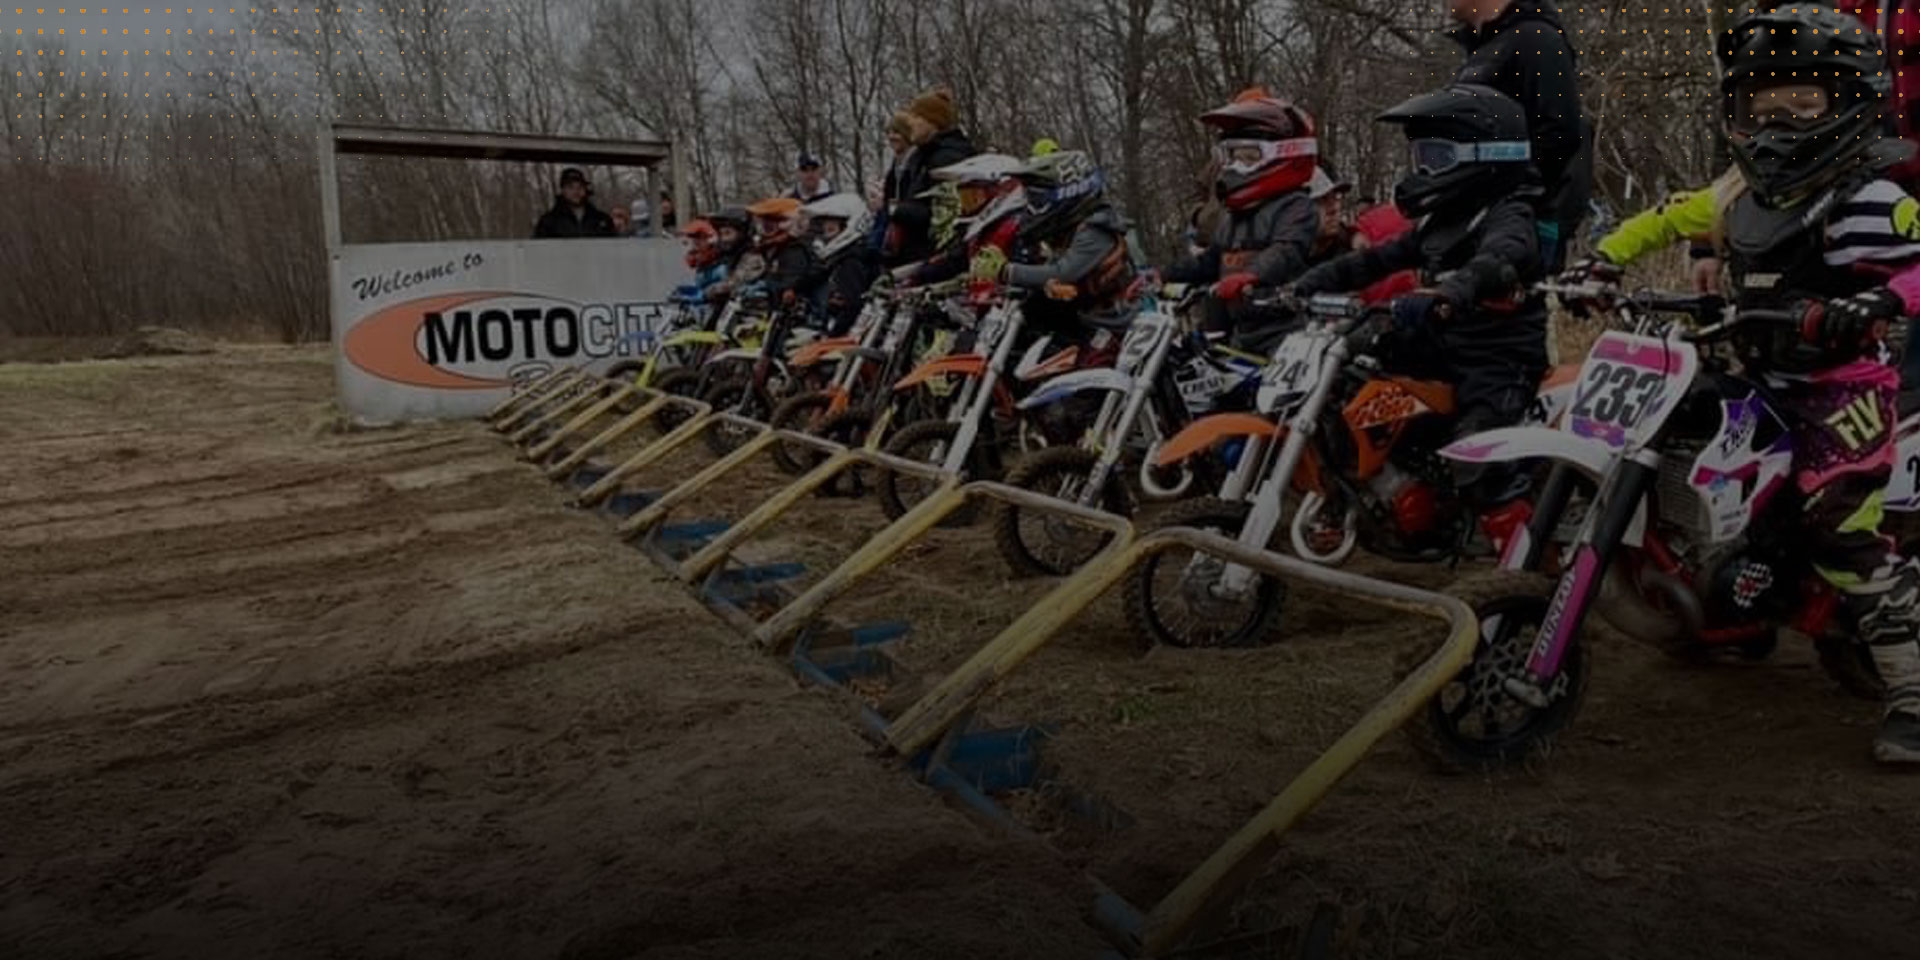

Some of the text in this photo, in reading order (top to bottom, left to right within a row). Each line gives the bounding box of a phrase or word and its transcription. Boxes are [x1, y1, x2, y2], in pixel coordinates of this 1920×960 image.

[352, 253, 483, 300] Welcome to
[1571, 361, 1665, 428] 233
[1823, 389, 1884, 451] FLY
